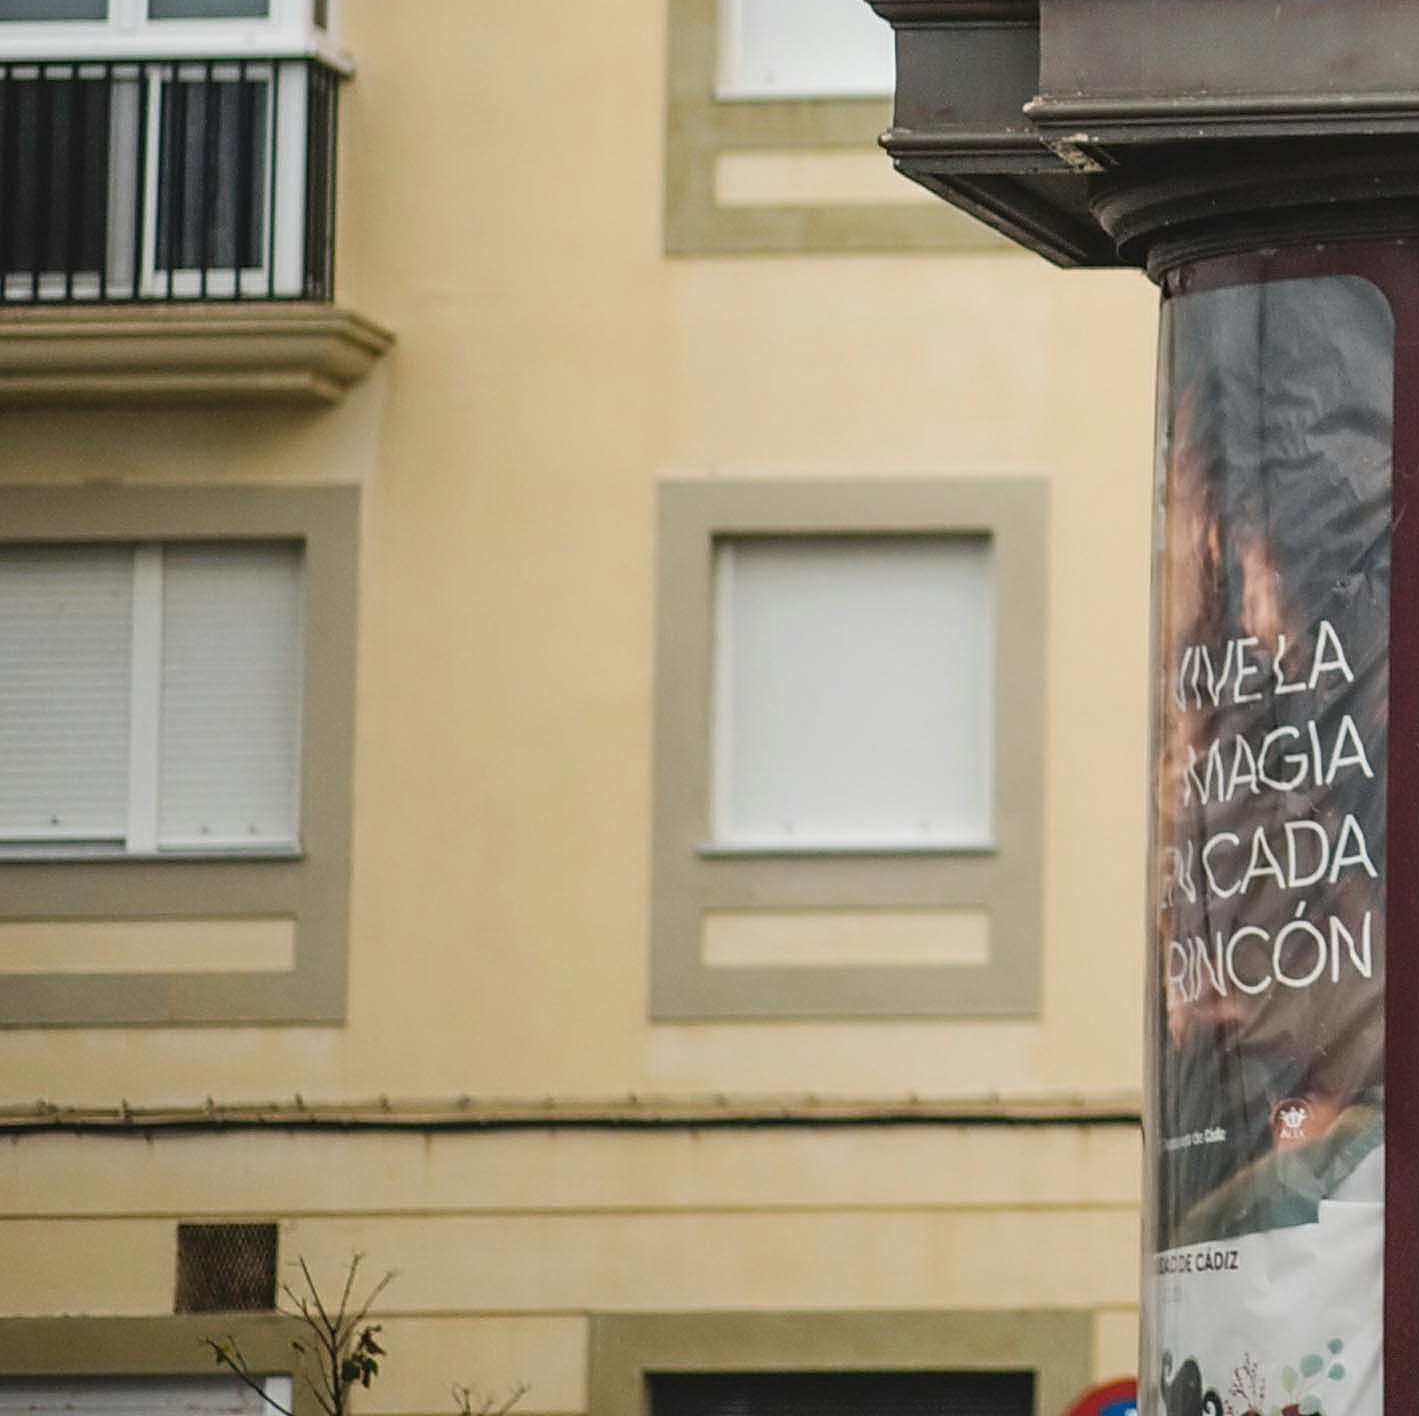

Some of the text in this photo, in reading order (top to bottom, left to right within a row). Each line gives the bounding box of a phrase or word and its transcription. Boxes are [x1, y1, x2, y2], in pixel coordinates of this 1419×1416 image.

[1274, 620, 1354, 695] LA
[1184, 715, 1373, 806] MAGIA
[1203, 814, 1378, 898] CADA
[1167, 901, 1372, 1003] RINCÓN
[1195, 1246, 1239, 1273] CÁDIZ
